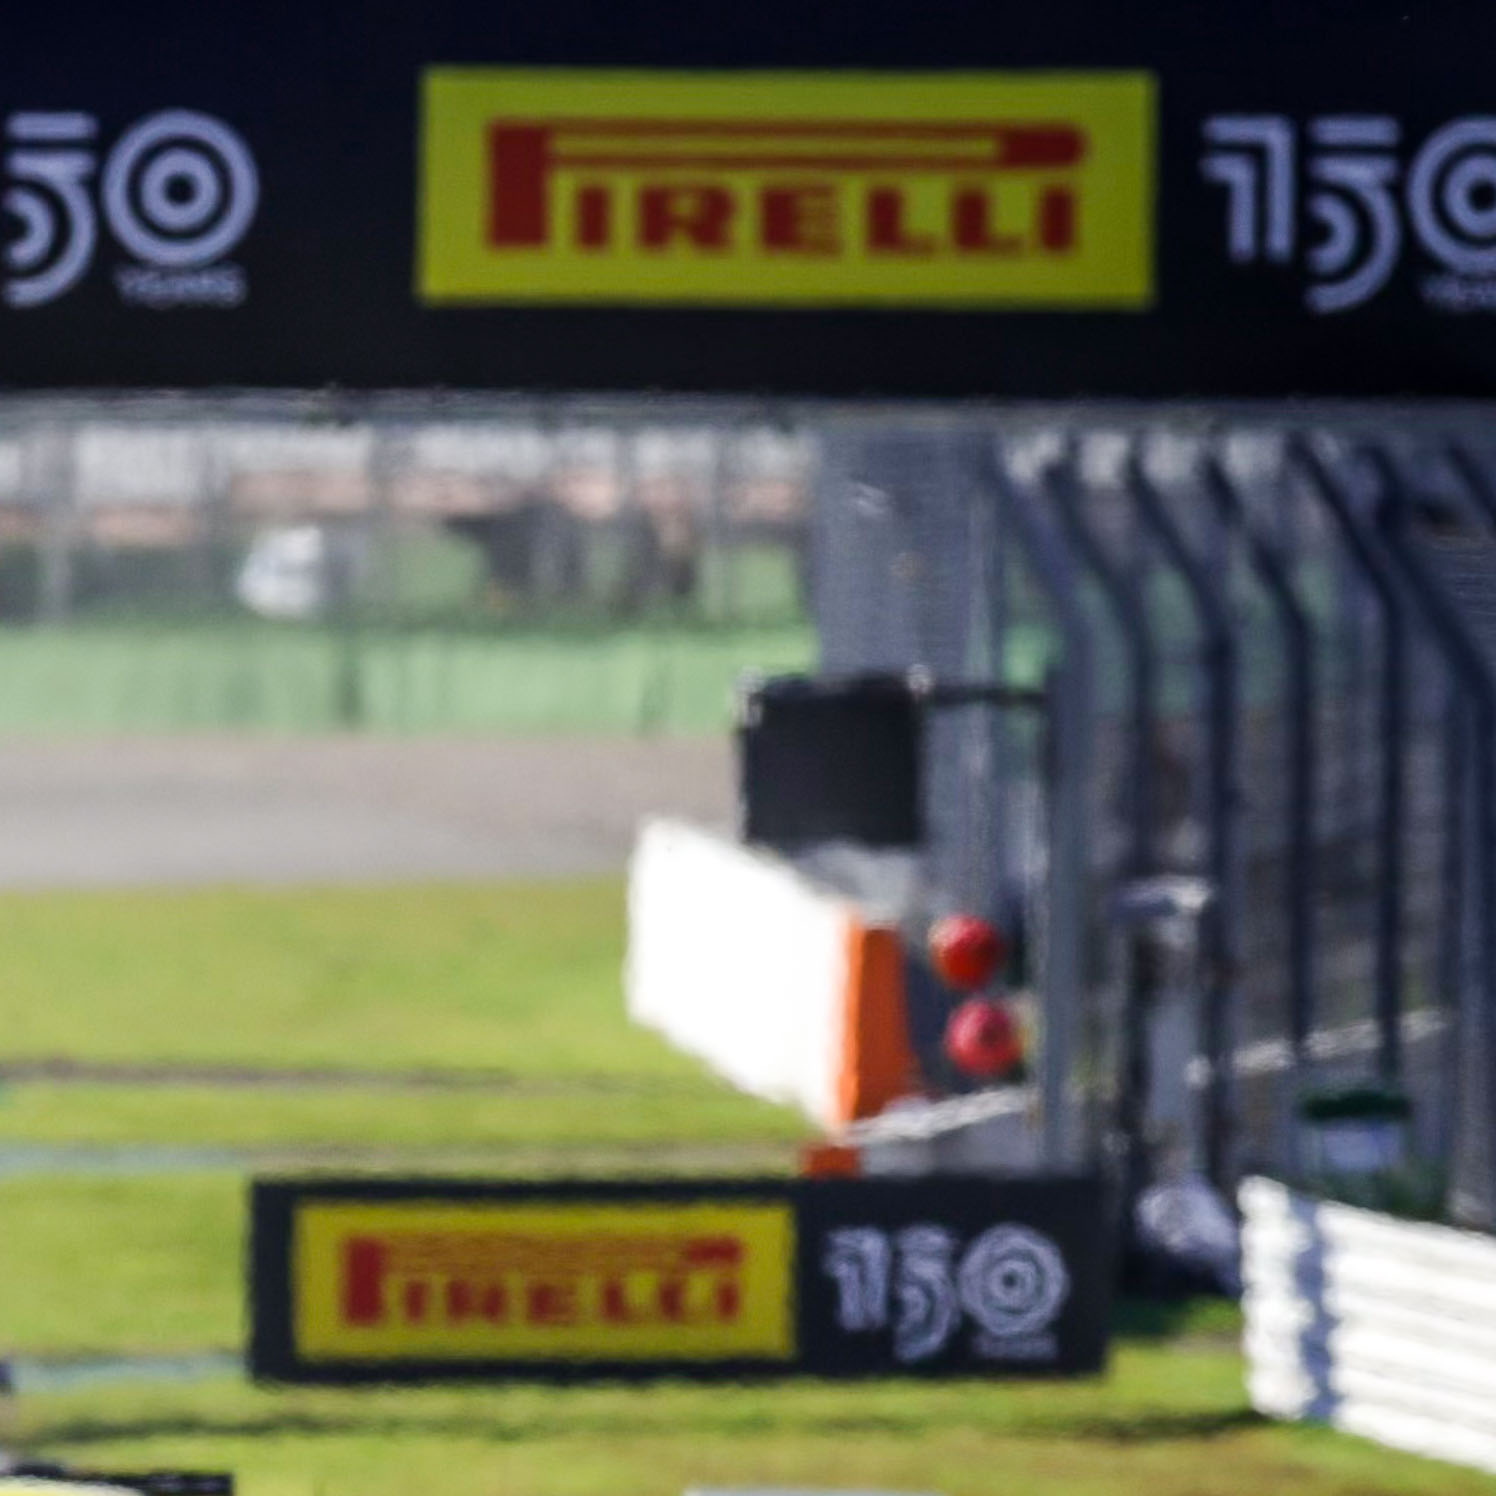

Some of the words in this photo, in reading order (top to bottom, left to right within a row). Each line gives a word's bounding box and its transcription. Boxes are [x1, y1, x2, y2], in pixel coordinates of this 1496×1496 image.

[483, 117, 1085, 257] PIRELLI
[343, 1229, 743, 1329] PIRELLI
[824, 1222, 1070, 1362] 150
